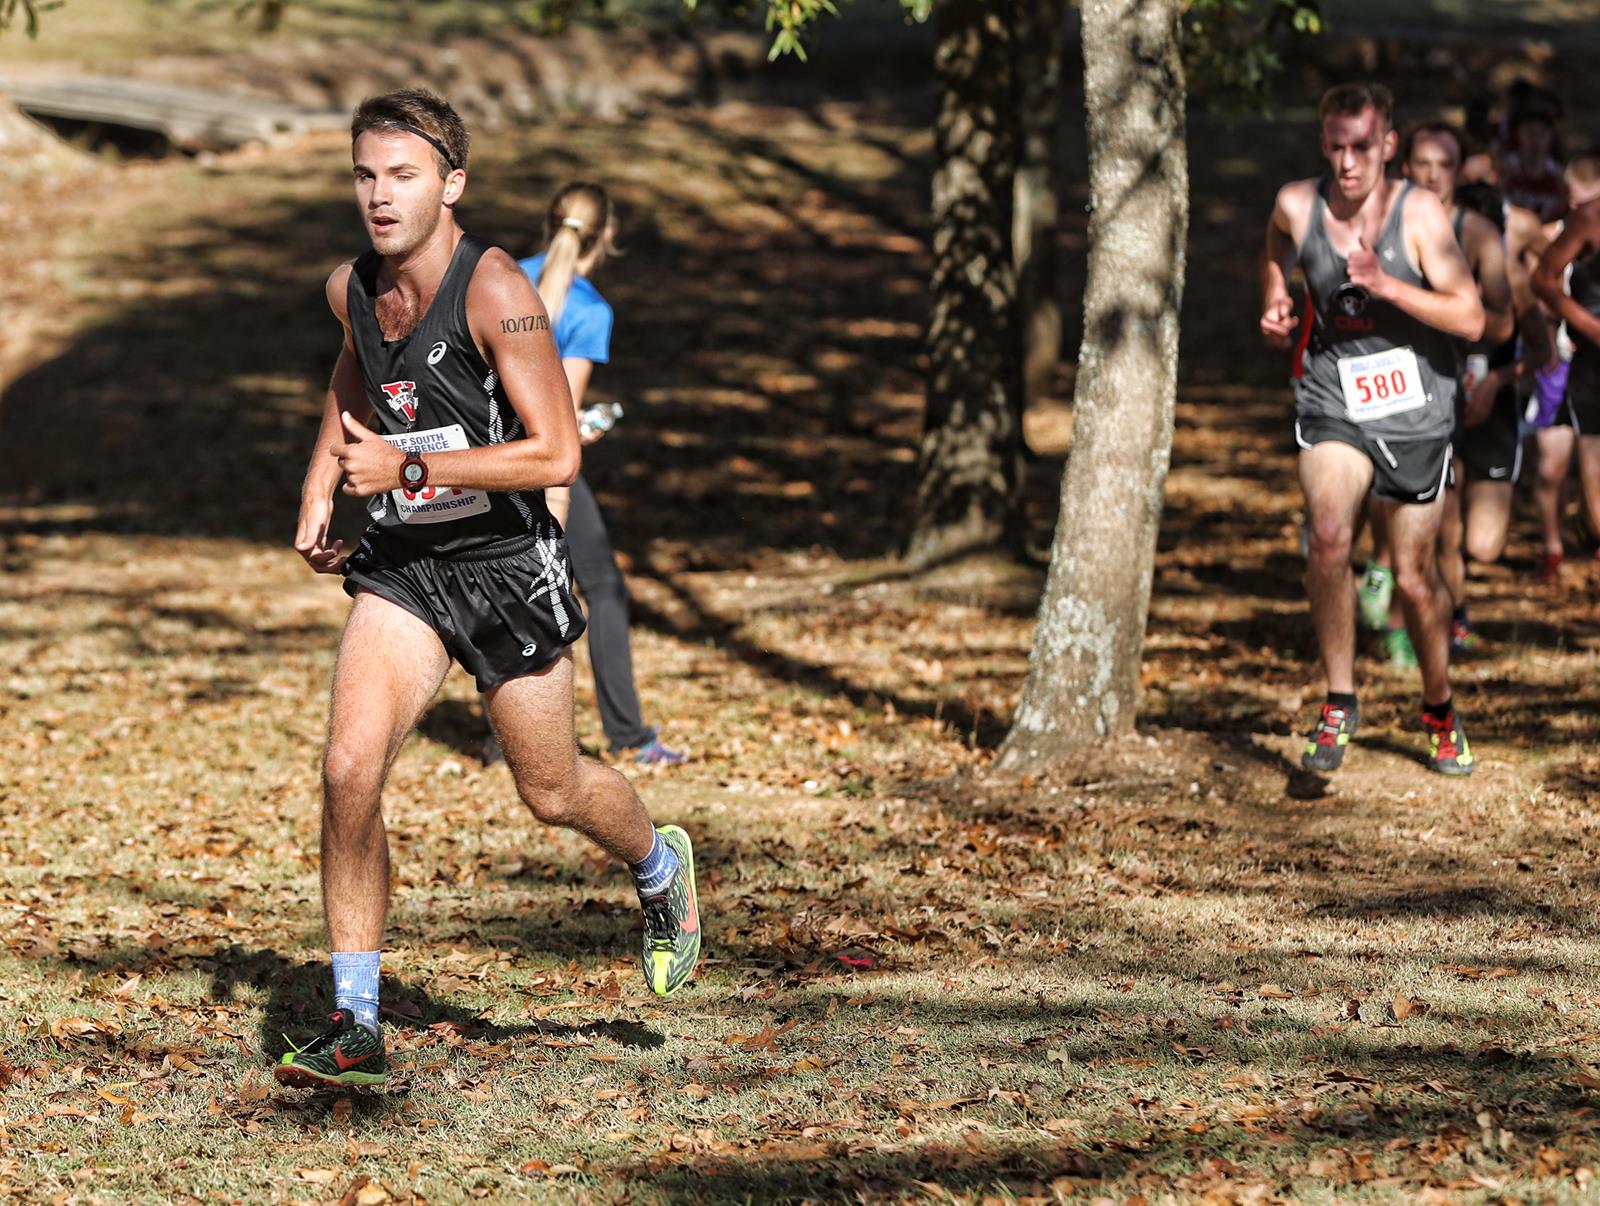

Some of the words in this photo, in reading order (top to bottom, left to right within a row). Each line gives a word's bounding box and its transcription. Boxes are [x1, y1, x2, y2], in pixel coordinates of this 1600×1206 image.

[1355, 369, 1407, 404] 580
[409, 432, 445, 446] SOUTH
[400, 495, 477, 513] CHAMPIONSHIP
